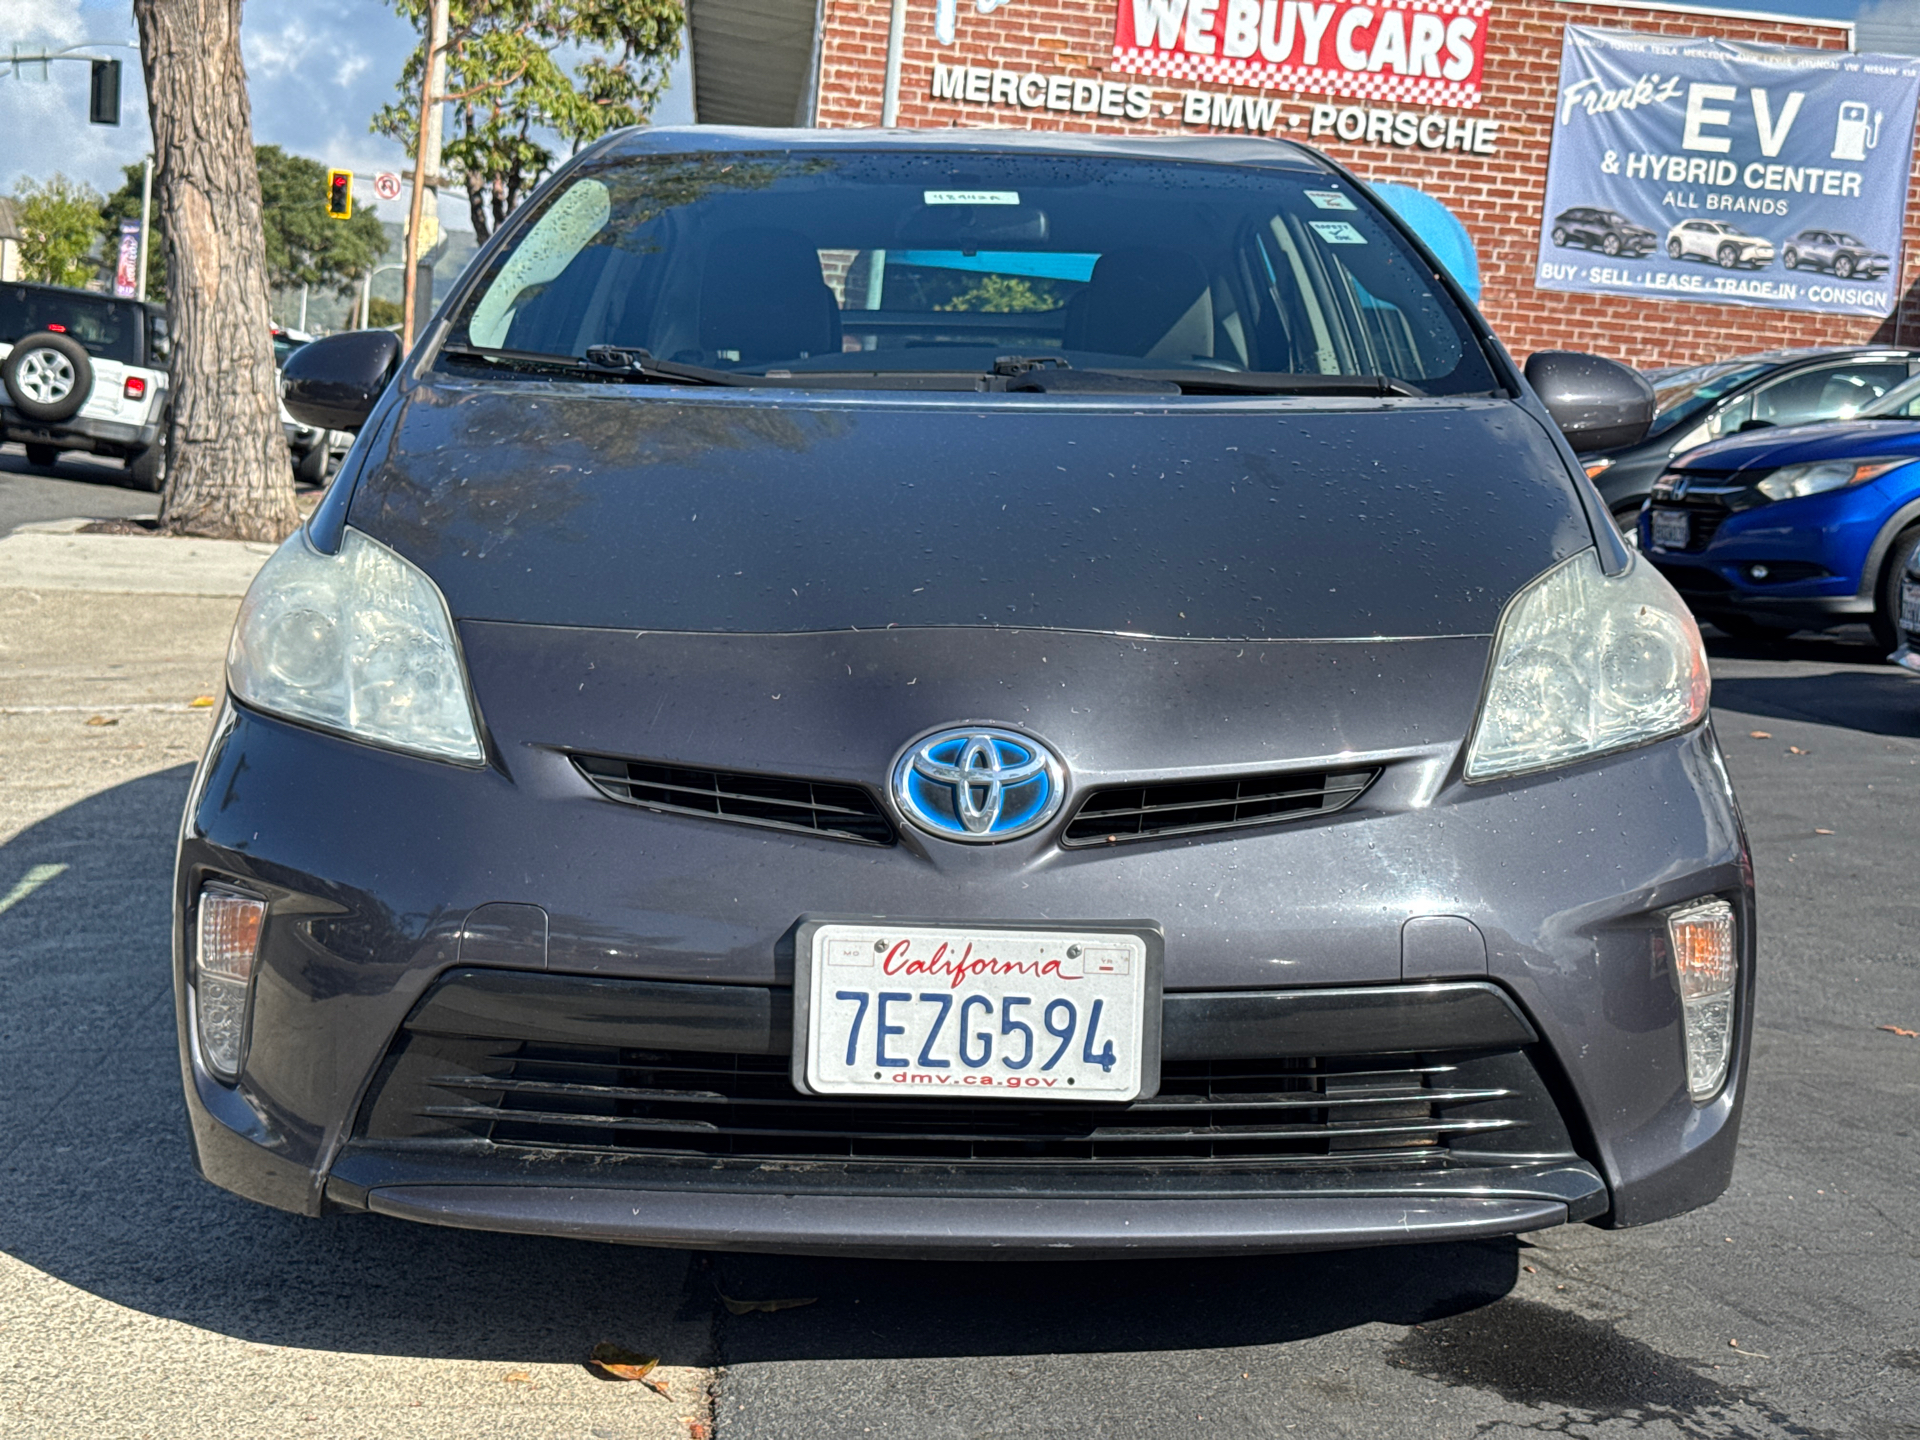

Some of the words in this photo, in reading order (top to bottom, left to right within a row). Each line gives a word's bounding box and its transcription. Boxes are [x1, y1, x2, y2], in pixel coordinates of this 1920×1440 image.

[1133, 0, 1220, 55] WE
[1222, 0, 1336, 66] BUY
[1335, 6, 1478, 82] CARS
[1651, 46, 1677, 56] TESLA
[1864, 64, 1897, 76] NISSAN
[932, 64, 1150, 118] MERCEDES
[1184, 90, 1282, 132] BMW
[1311, 103, 1499, 154] PORSCHE
[1561, 73, 1684, 126] Frank's
[1600, 150, 1620, 174] &
[1626, 154, 1738, 186] HYBRID
[1743, 164, 1863, 197] CENTER
[1662, 190, 1700, 209] ALL
[1705, 193, 1789, 216] BRANDS
[1541, 263, 1578, 281] BUY
[1588, 267, 1633, 285] SELL
[1644, 272, 1702, 291] LEASE
[1714, 277, 1797, 300] TRADE-IN
[1808, 285, 1887, 307] CONSIGN
[883, 939, 1084, 989] California
[835, 990, 1117, 1073] 7EZG594
[892, 1071, 1058, 1088] dmv.ca.gov
